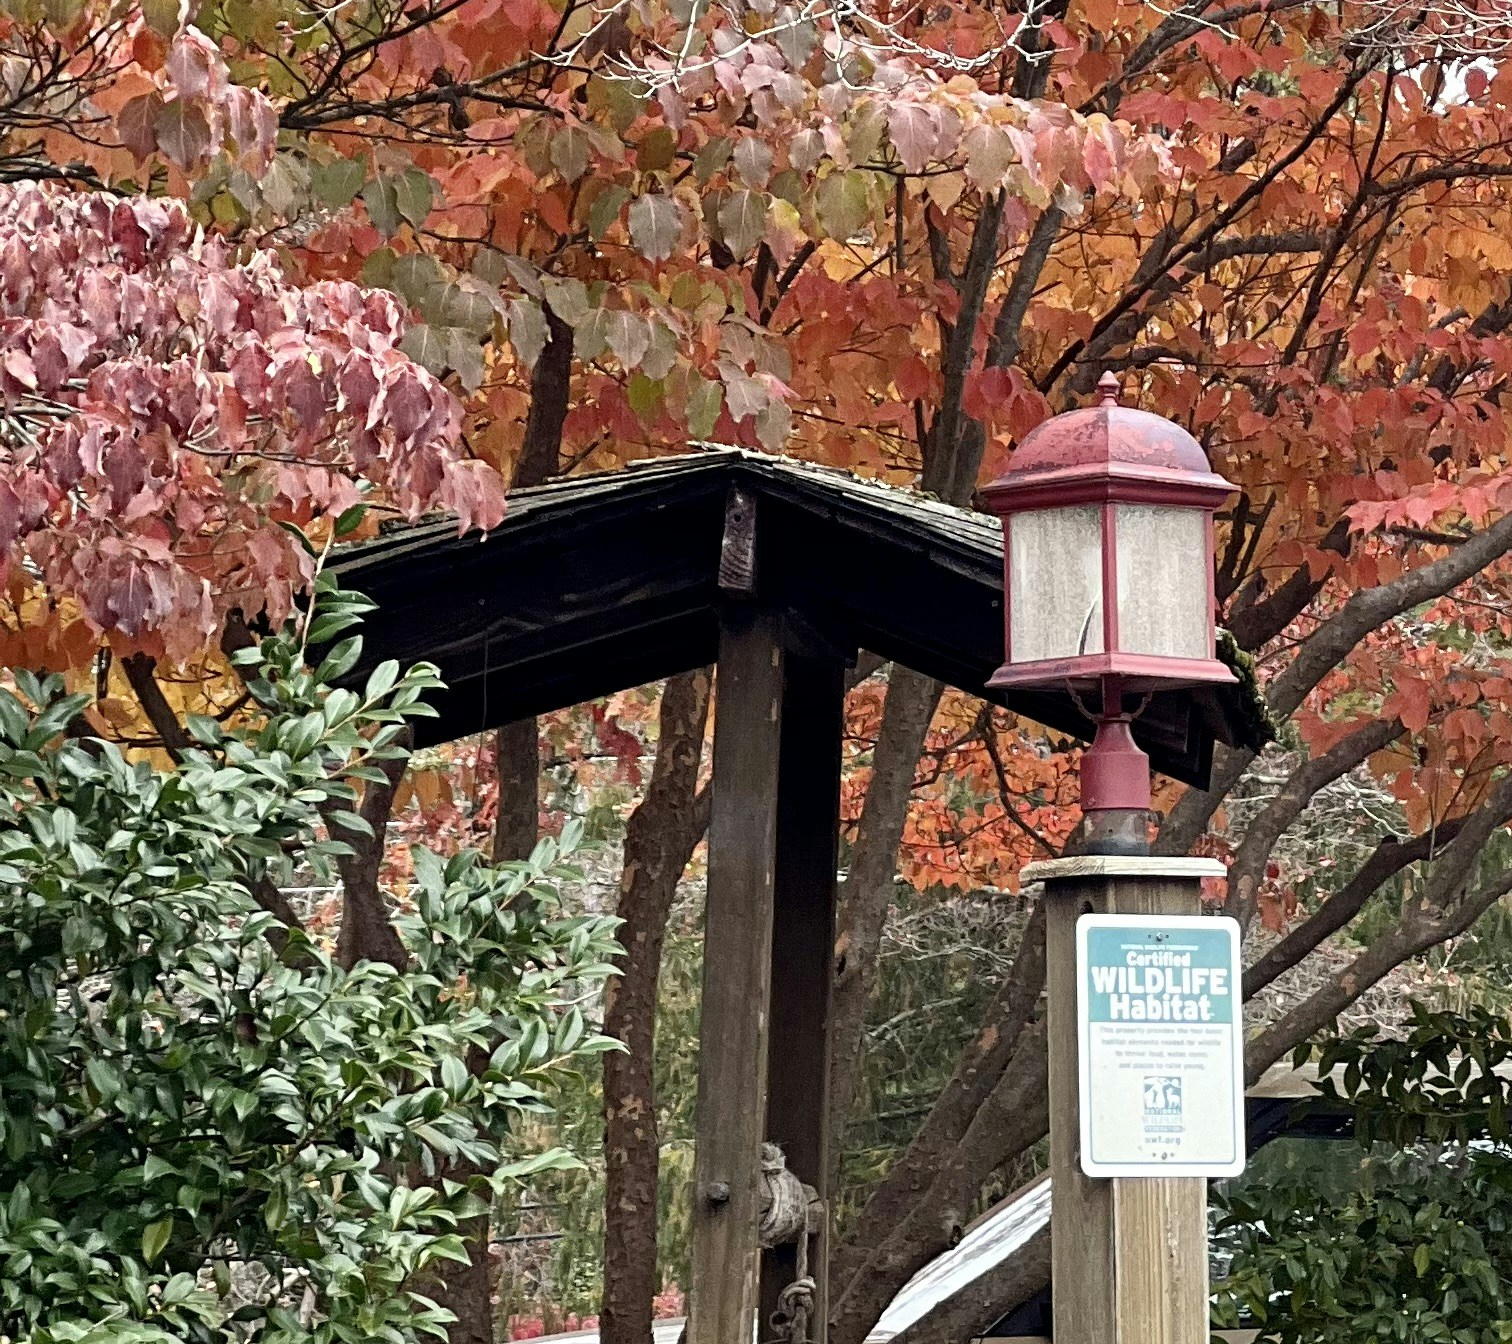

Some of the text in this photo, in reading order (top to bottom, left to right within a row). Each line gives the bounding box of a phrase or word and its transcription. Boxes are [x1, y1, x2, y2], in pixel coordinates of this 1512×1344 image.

[1126, 951, 1191, 966] Certified
[1091, 966, 1228, 995] WILDLIFE
[1110, 993, 1212, 1020] Habitat
